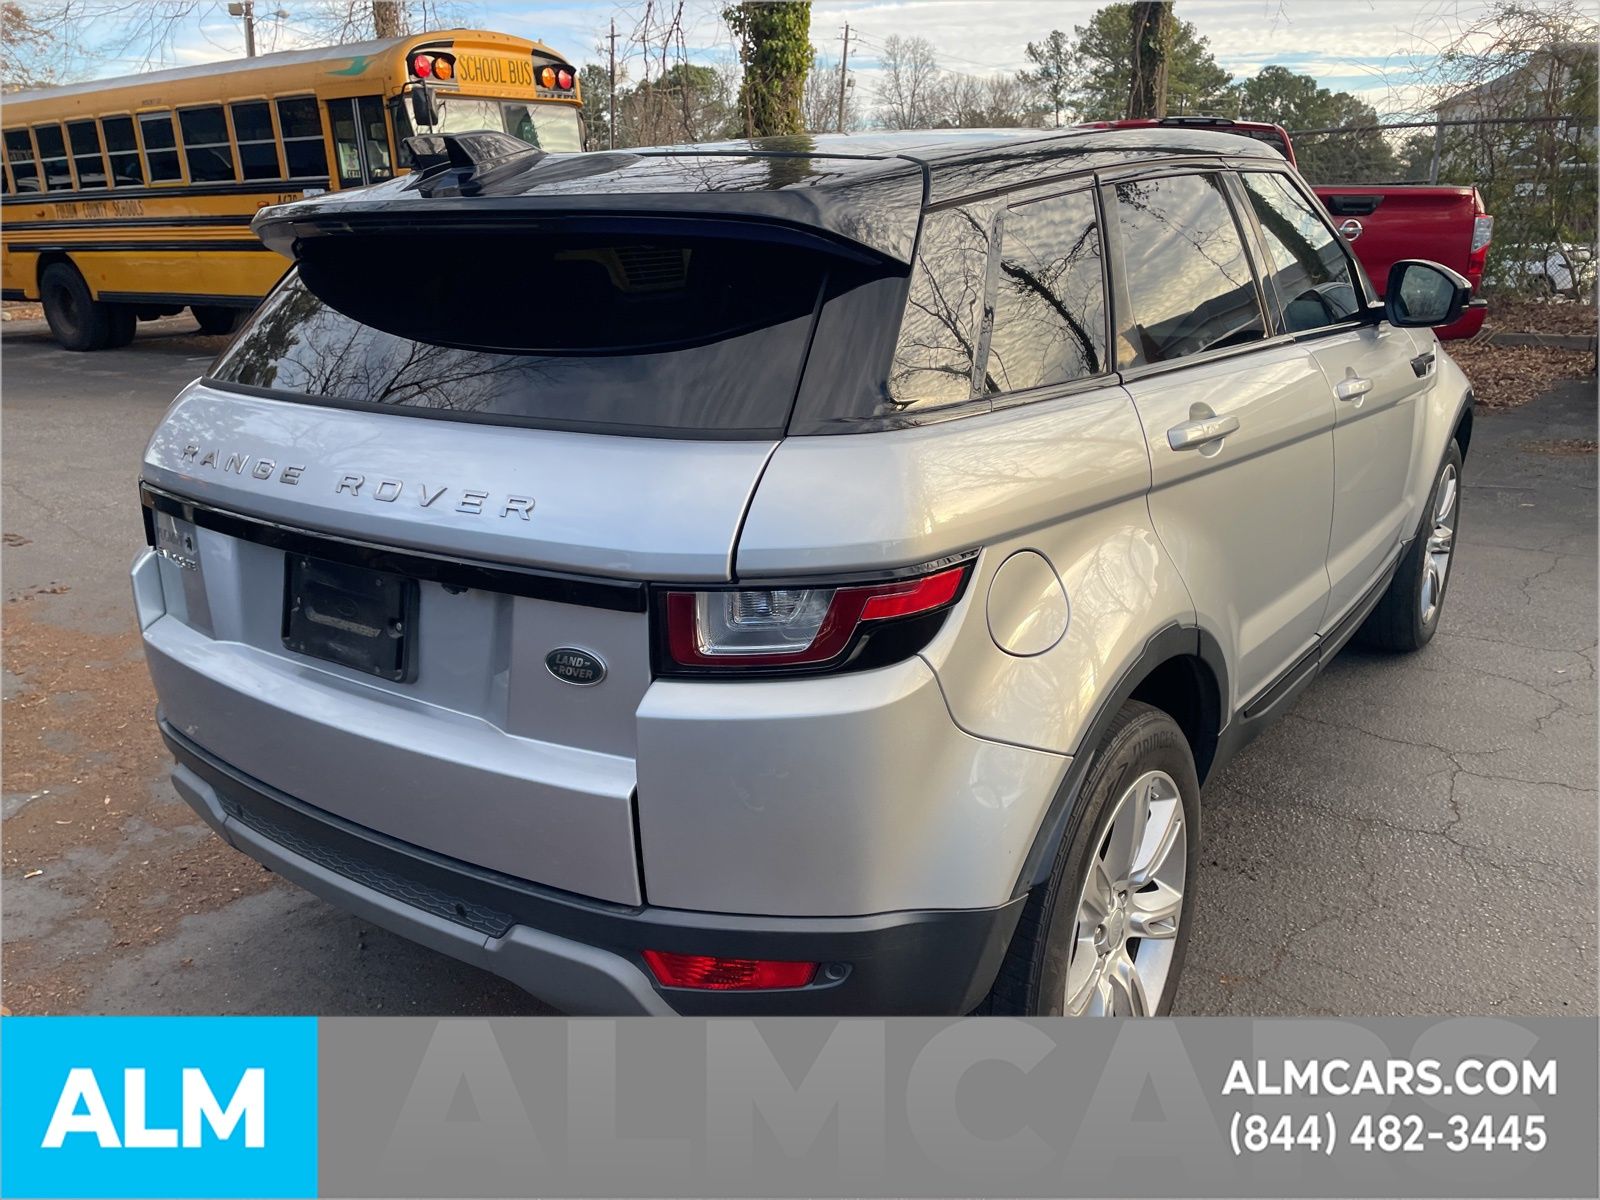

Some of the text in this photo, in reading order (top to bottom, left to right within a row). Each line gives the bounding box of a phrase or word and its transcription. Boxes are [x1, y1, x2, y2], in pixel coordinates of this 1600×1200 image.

[459, 55, 532, 86] SCHOOL BUS
[82, 202, 108, 218] COUNTY
[112, 200, 144, 217] SCHOOLS
[180, 444, 536, 521] RANGE ROVER
